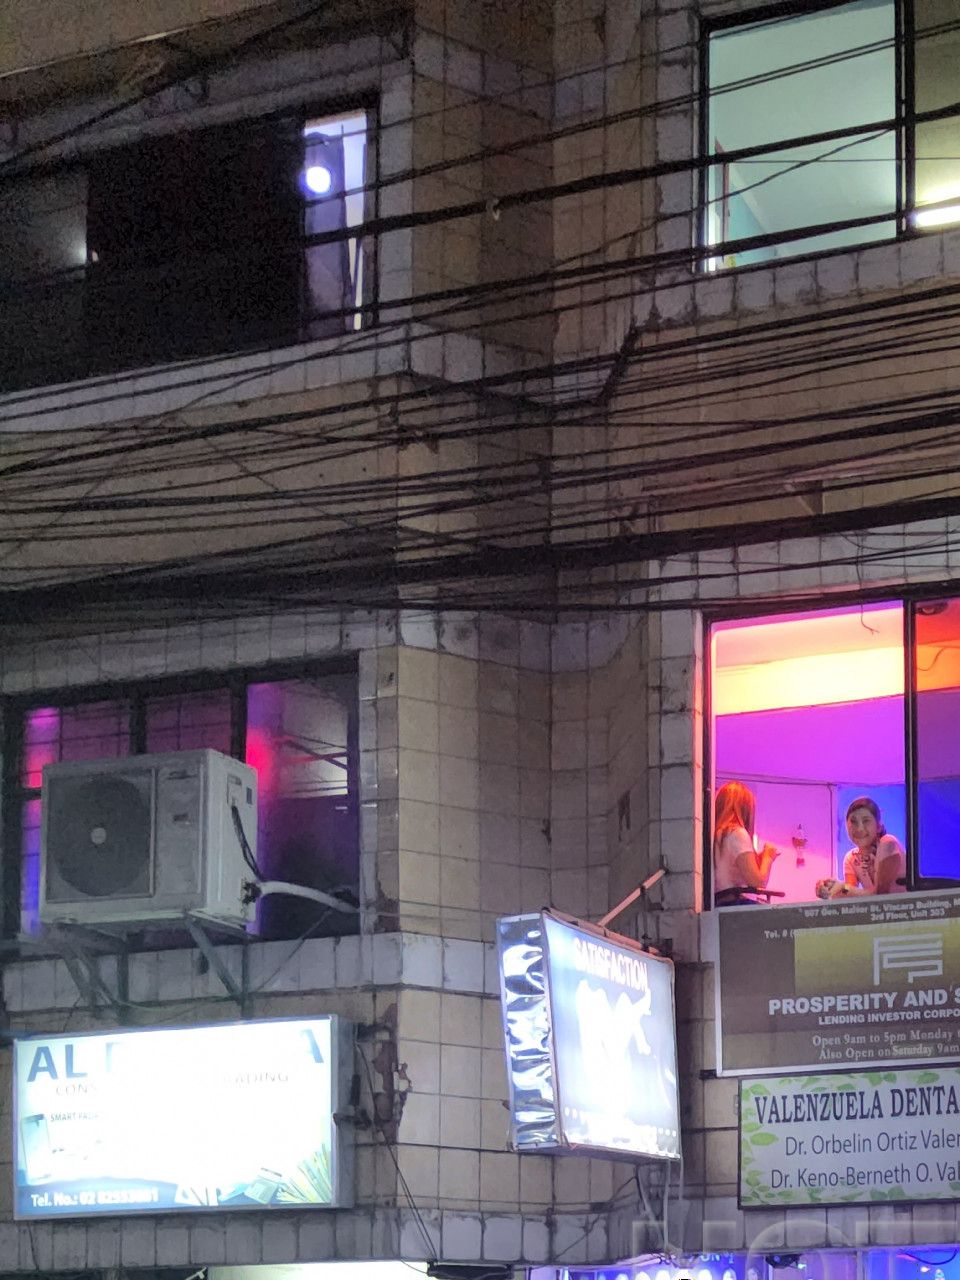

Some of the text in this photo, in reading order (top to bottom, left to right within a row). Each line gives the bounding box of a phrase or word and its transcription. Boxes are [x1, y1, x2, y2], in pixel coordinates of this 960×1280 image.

[574, 937, 648, 991] SATISFACTION
[769, 991, 898, 1015] PROSPERITY
[903, 989, 948, 1007] AND
[818, 1014, 865, 1025] LENDING
[867, 1011, 921, 1023] INVESTOR
[812, 1035, 840, 1048] Open
[843, 1033, 866, 1044] 9am
[869, 1033, 880, 1043] to
[883, 1031, 906, 1044] 5pm
[910, 1028, 953, 1042] Monday
[819, 1047, 842, 1060] Also
[845, 1047, 874, 1060] Open
[878, 1048, 890, 1057] on
[892, 1043, 934, 1057] Saturday
[937, 1042, 960, 1053] 9am
[755, 1090, 884, 1124] VALENZUELA
[786, 1136, 807, 1156] Dr.
[812, 1133, 872, 1155] Orbelin
[877, 1131, 917, 1151] Ortiz
[771, 1168, 793, 1188] Dr.
[797, 1163, 911, 1187] Keno-Berneth
[916, 1162, 933, 1182] O.
[31, 1193, 51, 1206] Tel.
